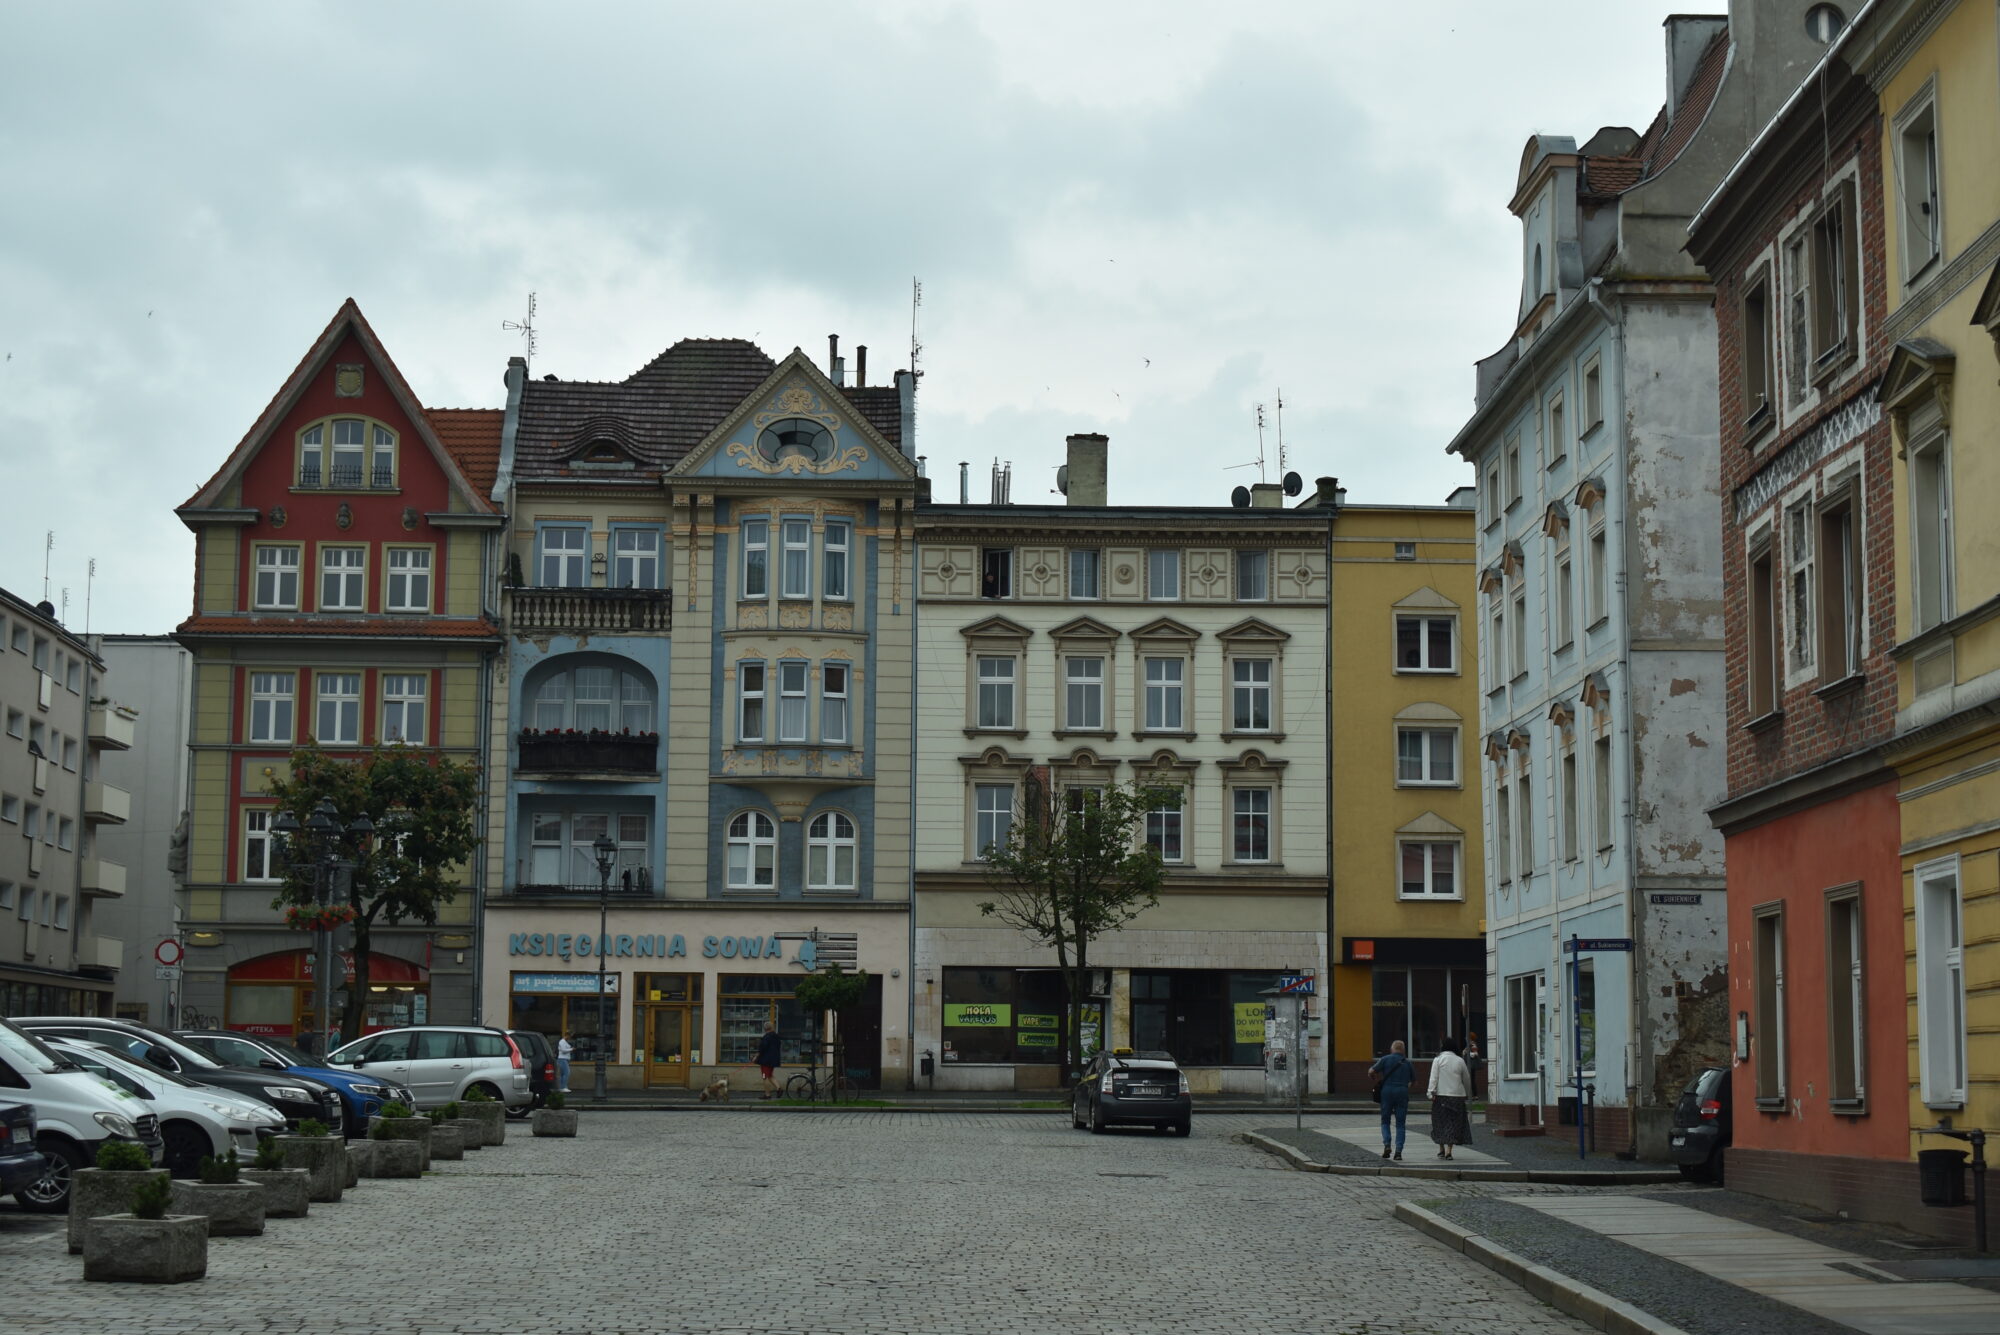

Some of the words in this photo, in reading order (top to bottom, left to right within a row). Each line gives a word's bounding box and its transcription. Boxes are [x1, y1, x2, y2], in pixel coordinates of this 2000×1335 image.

[1663, 895, 1698, 903] SUKIENNICE
[509, 933, 687, 961] KSIĘGARNIA
[702, 934, 783, 959] SOWA
[533, 975, 596, 988] papiernicze
[1281, 977, 1314, 991] TAXI
[966, 1006, 991, 1014] HOLA
[958, 1014, 997, 1024] VAPEROS
